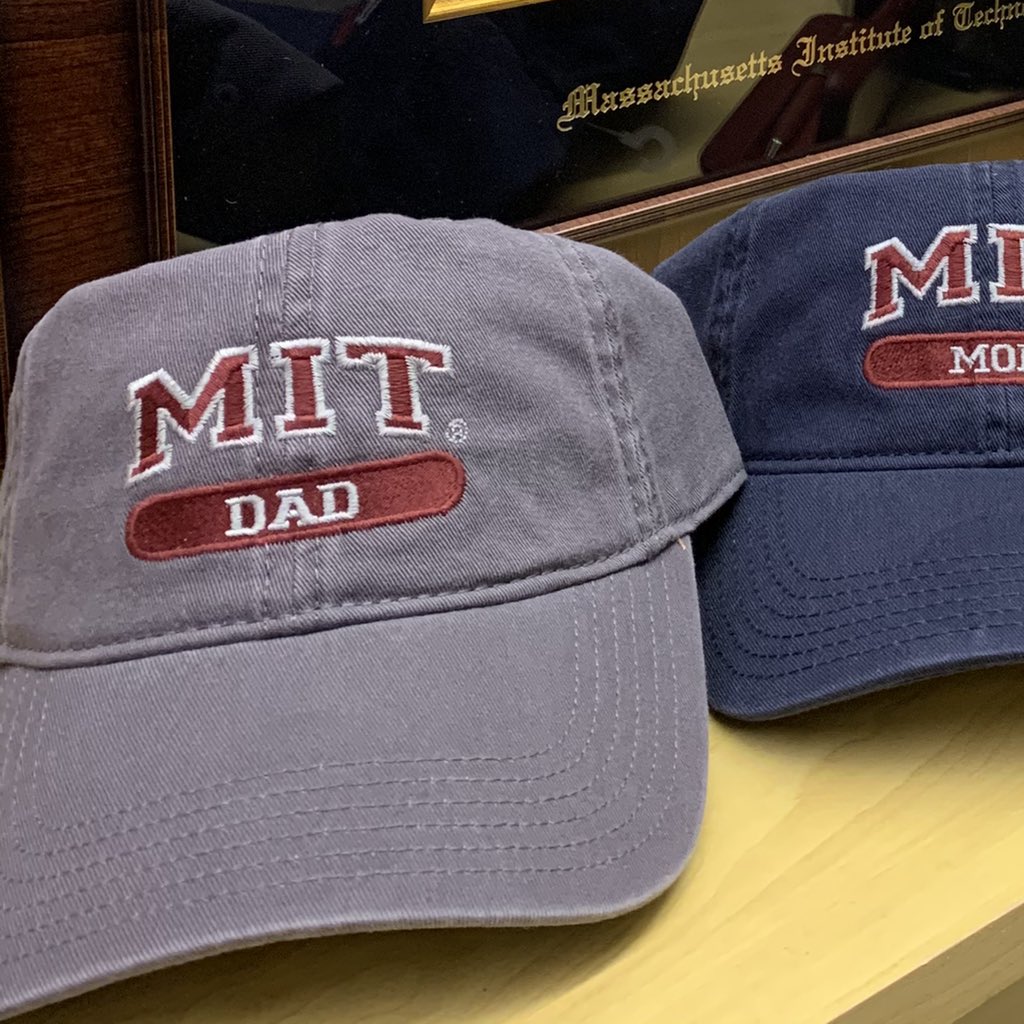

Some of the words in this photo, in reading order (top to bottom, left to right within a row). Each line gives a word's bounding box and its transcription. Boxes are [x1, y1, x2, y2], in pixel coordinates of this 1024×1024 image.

[556, 48, 782, 132] Massachusetts
[791, 21, 912, 76] Institute
[920, 8, 946, 41] of
[127, 335, 452, 487] MIT
[225, 481, 360, 537] DAD
